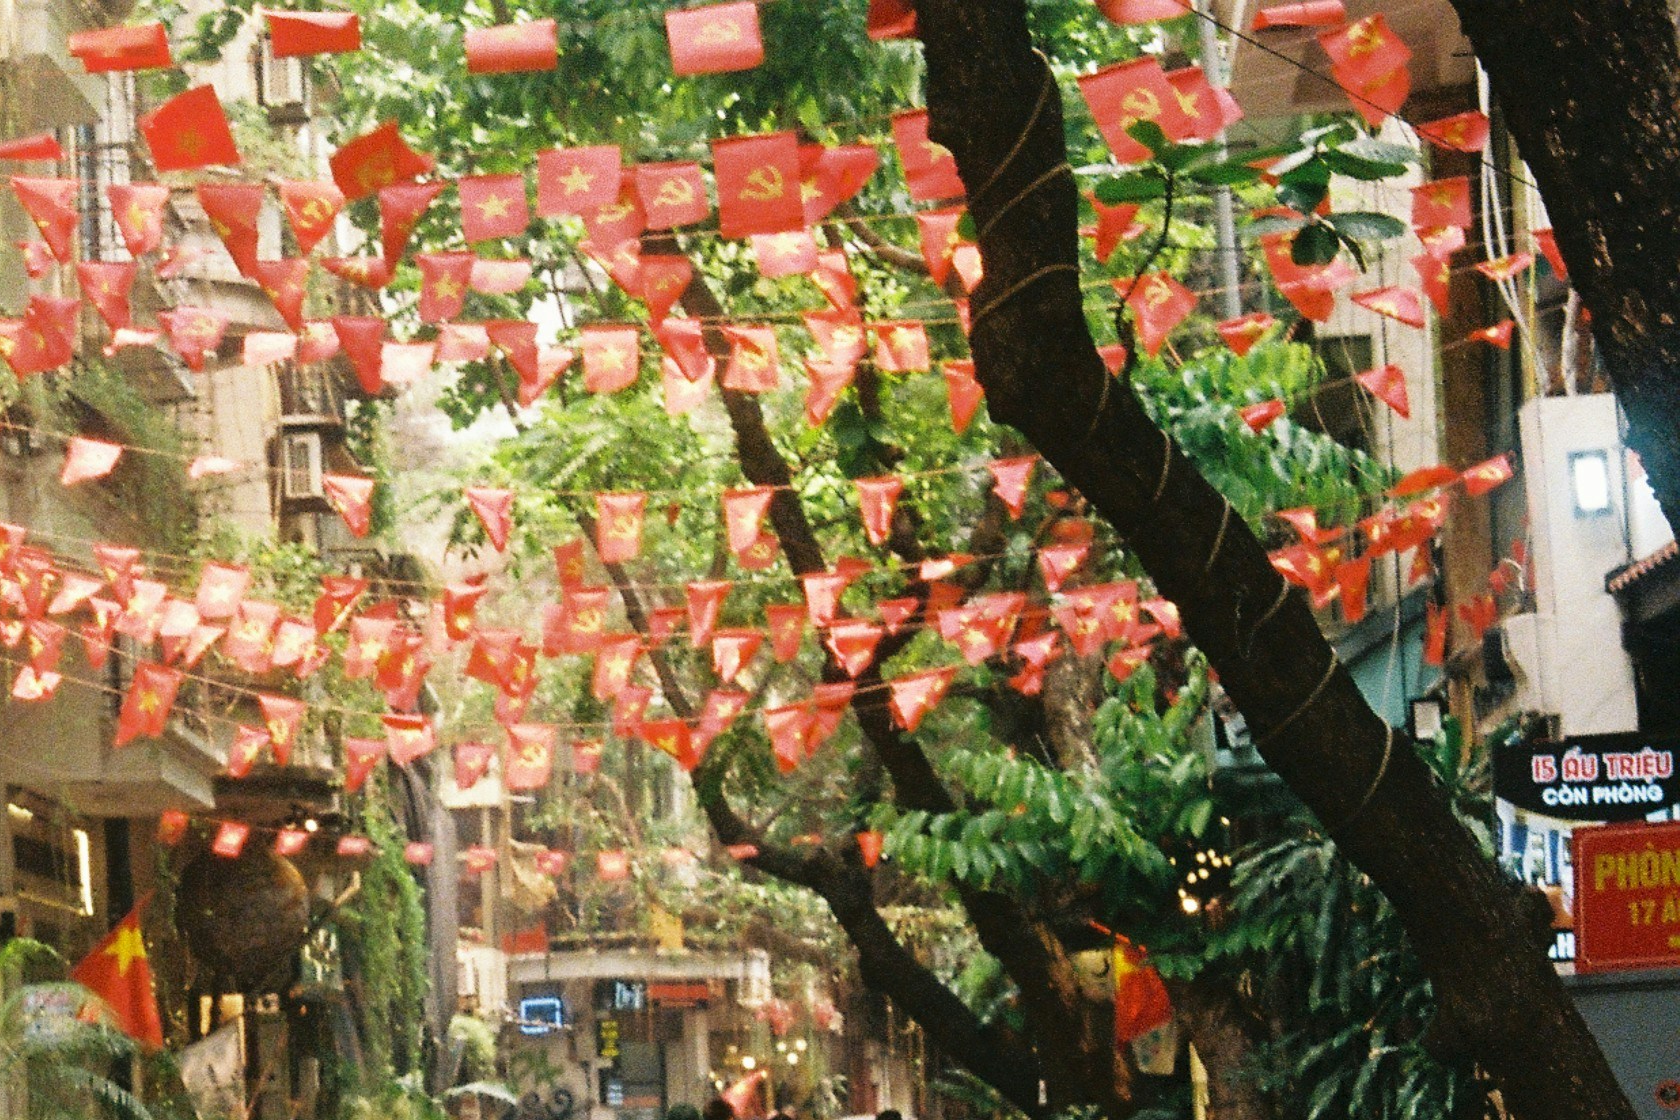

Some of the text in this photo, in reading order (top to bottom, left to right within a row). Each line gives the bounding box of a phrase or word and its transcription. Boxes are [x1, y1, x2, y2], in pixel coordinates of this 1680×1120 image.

[1531, 754, 1558, 783] 15
[1602, 746, 1673, 784] TRIỆU
[1542, 781, 1663, 806] CÒN PHÒNG
[1628, 899, 1656, 925] 17
